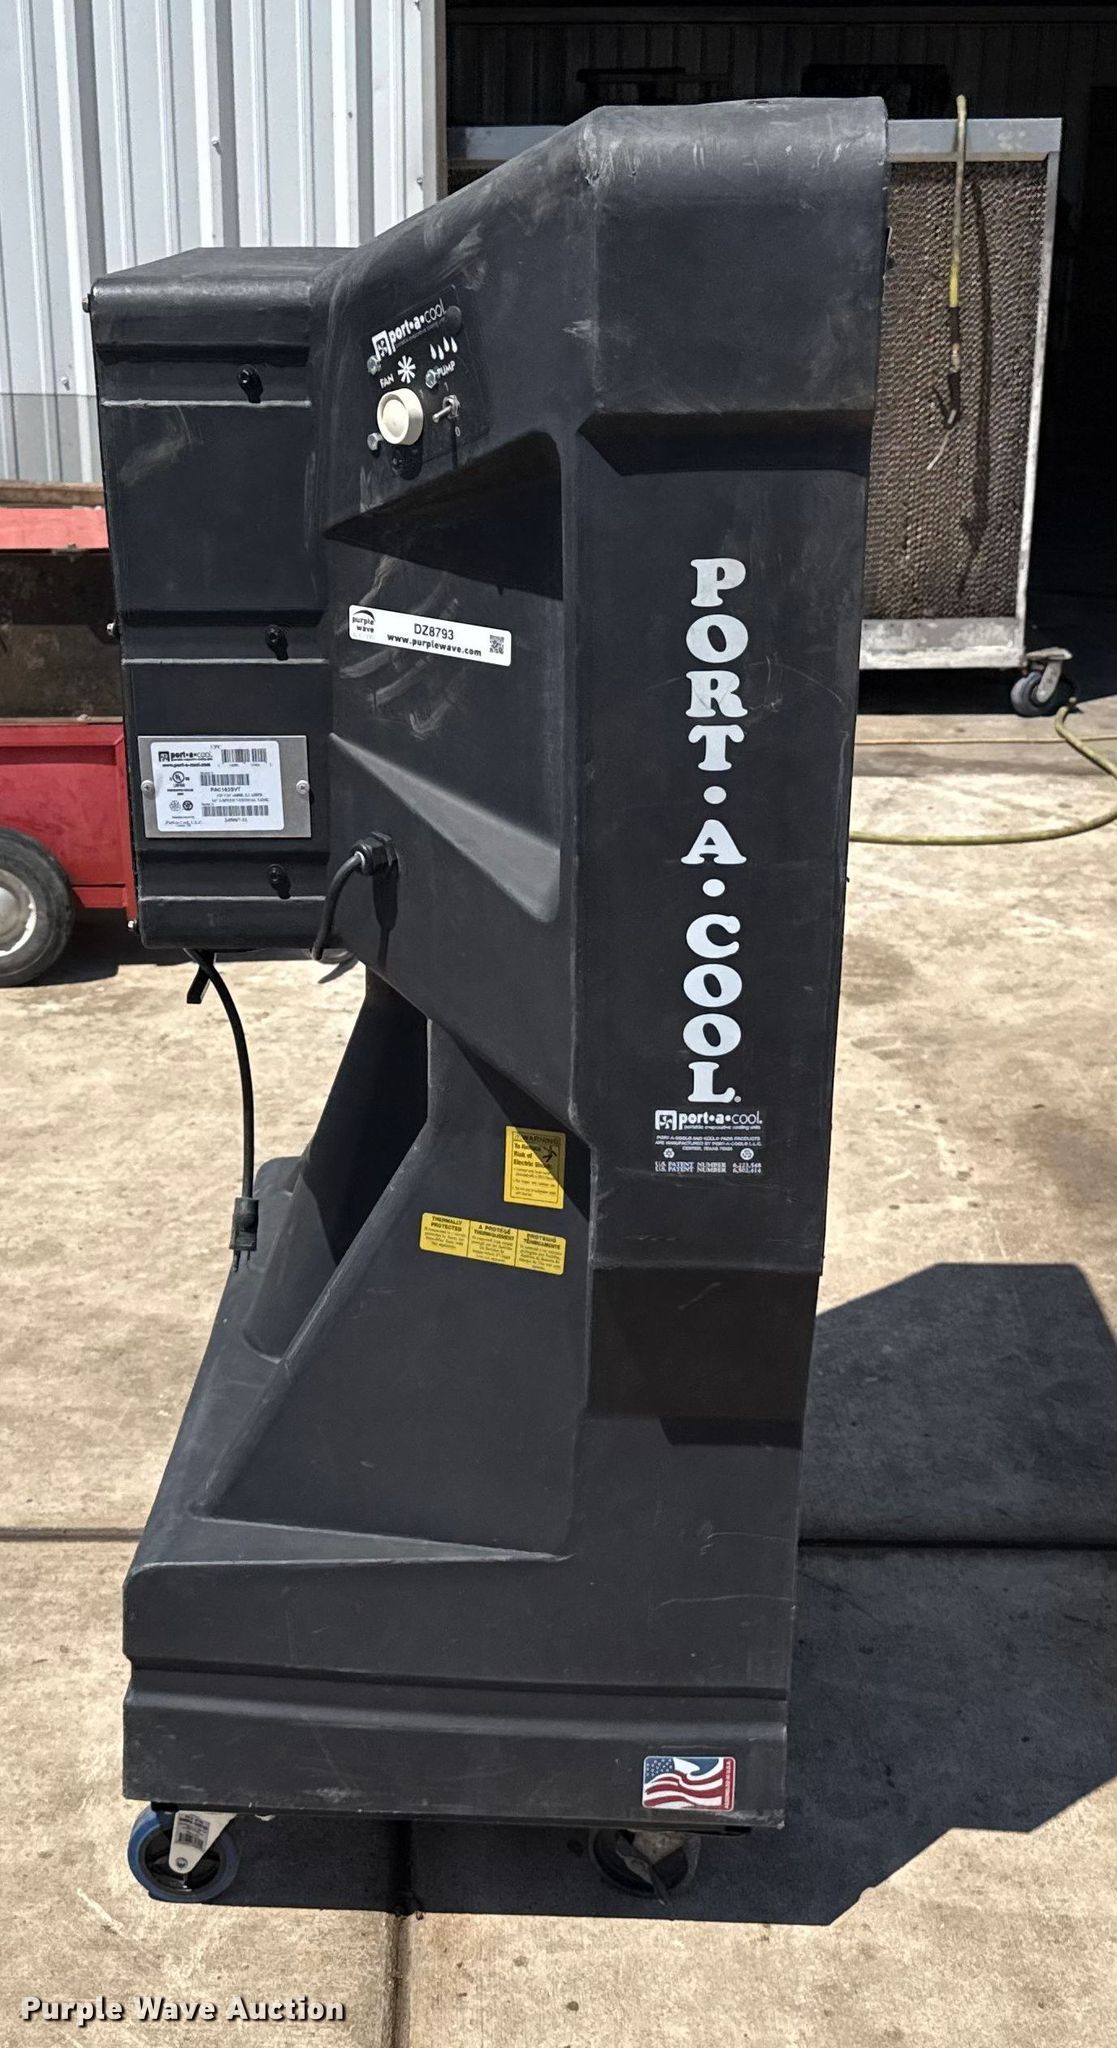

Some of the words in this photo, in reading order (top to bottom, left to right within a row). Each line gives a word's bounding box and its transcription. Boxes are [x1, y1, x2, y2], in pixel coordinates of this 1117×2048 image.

[437, 360, 456, 378] PUMP
[380, 373, 394, 389] FAN
[352, 616, 374, 626] purple
[356, 625, 374, 633] wave
[414, 623, 454, 640] DZ8793
[387, 633, 482, 656] www.purplewave.com
[513, 1159, 534, 1167] Electric
[432, 1216, 463, 1225] THERMALLY
[431, 1222, 462, 1232] PROTECTED
